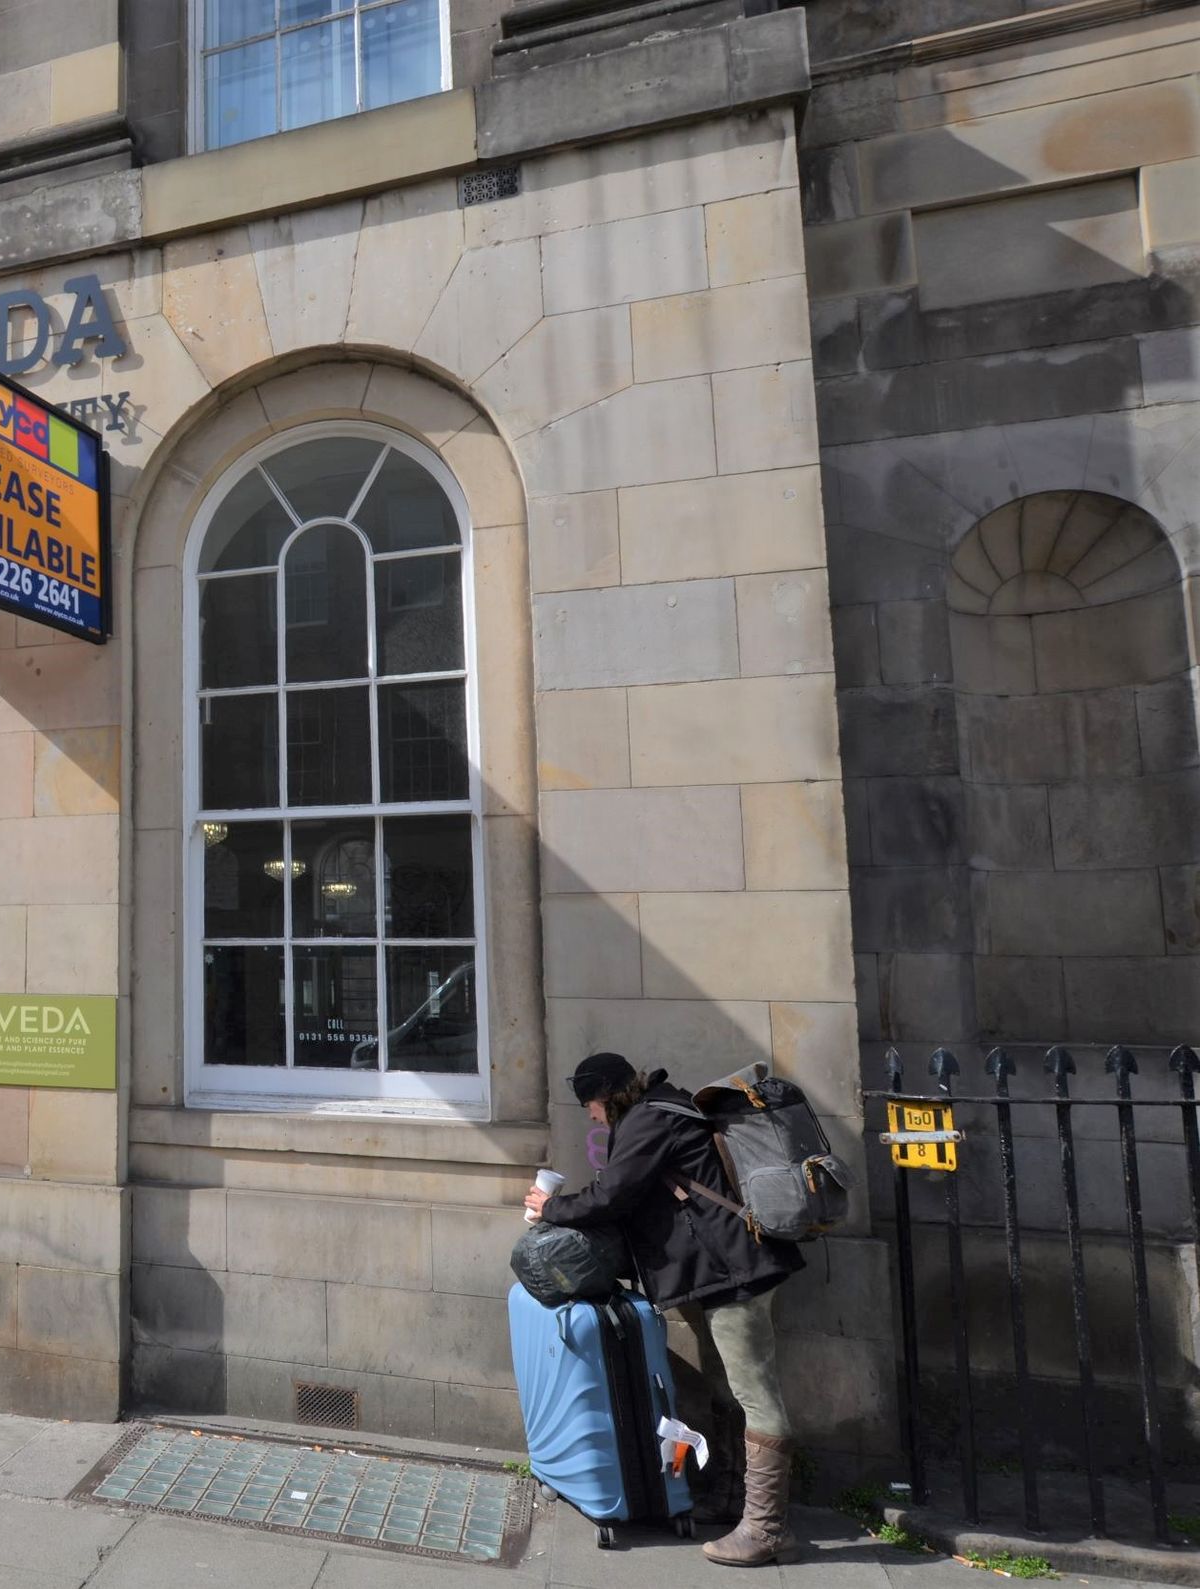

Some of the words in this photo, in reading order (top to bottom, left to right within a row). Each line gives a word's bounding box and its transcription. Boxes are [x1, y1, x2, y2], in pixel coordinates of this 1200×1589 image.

[17, 457, 74, 495] SURVEYORS
[37, 574, 80, 615] 2641
[327, 1018, 345, 1030] CALL
[4, 1036, 20, 1044] AND
[22, 1036, 54, 1045] SCIENCE
[56, 1037, 66, 1045] OF
[68, 1038, 87, 1046] PURE
[299, 1032, 323, 1041] 0131
[327, 1033, 345, 1041] 556
[6, 1044, 22, 1052] AND
[24, 1045, 47, 1053] PLANT
[48, 1046, 85, 1055] ESSENCES
